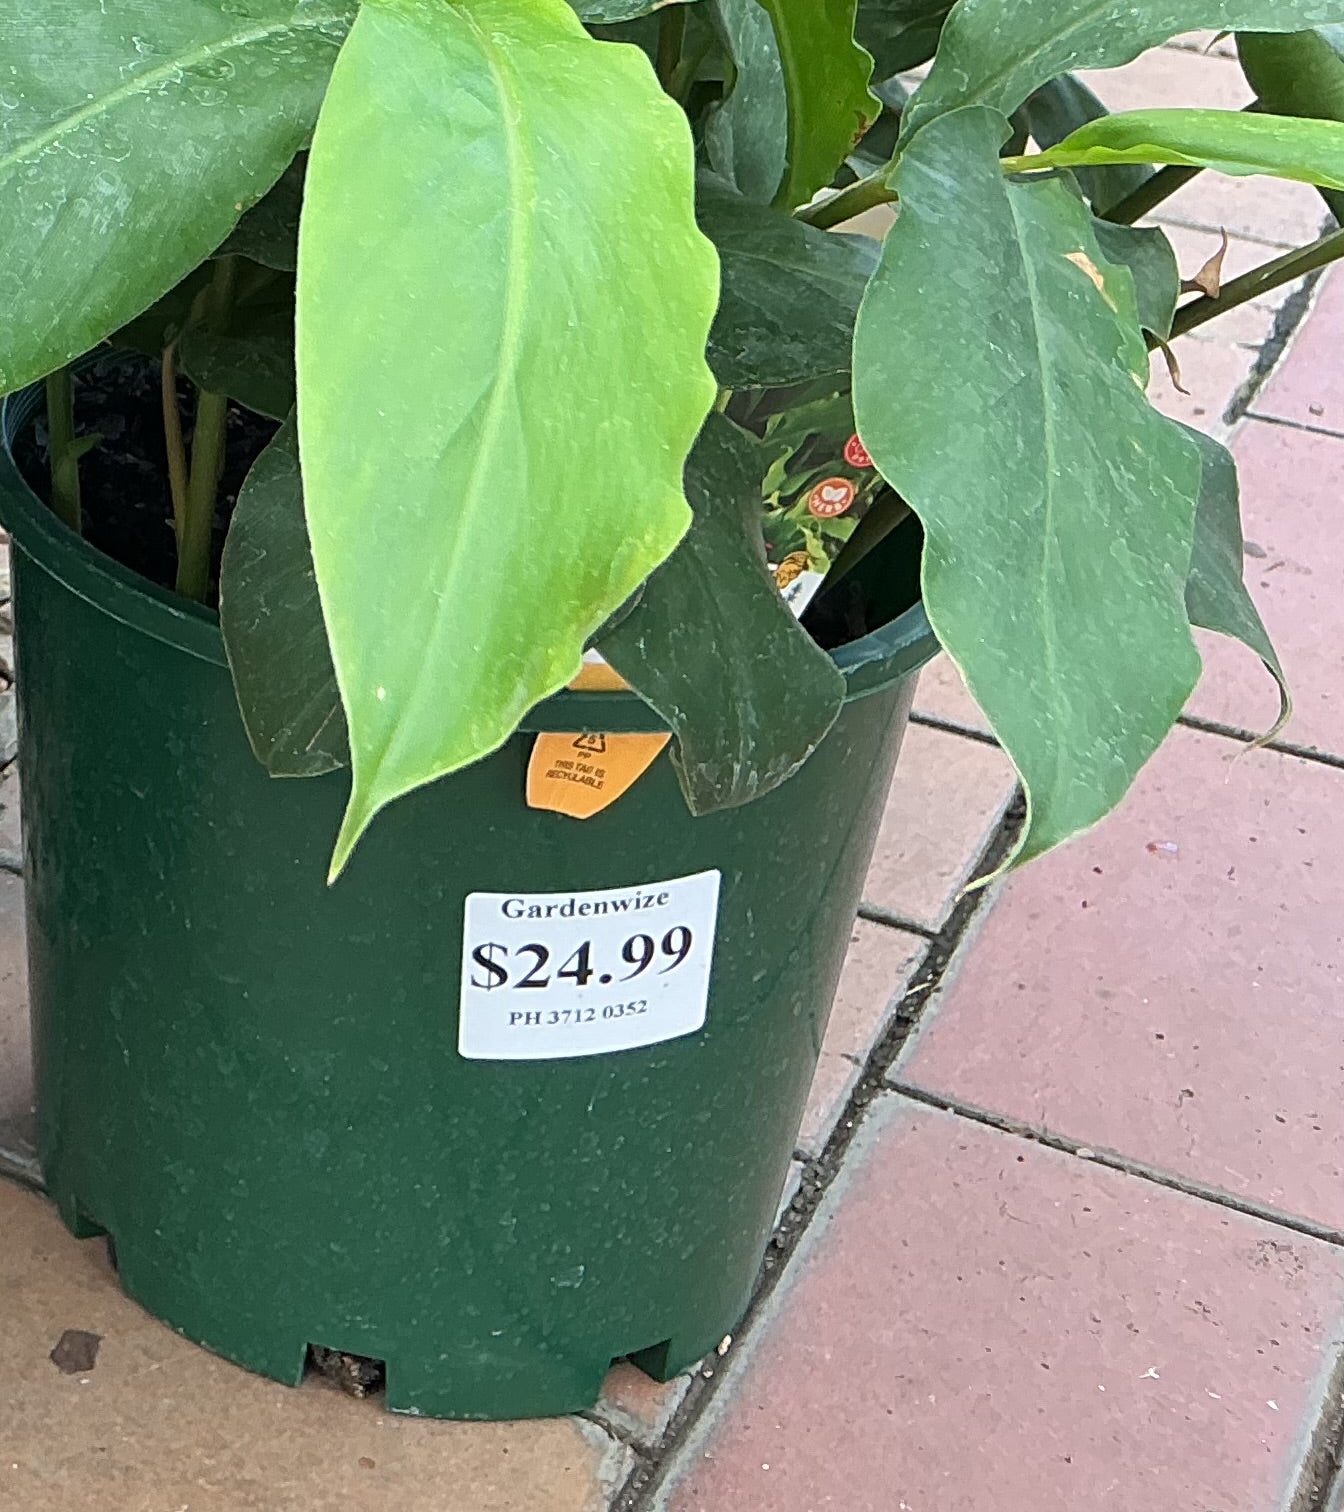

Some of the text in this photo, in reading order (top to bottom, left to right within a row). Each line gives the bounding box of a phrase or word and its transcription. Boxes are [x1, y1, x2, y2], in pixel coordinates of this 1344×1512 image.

[501, 890, 670, 919] Gardenwize
[470, 924, 693, 992] $24.99
[509, 999, 648, 1026] PH 3712 0352
